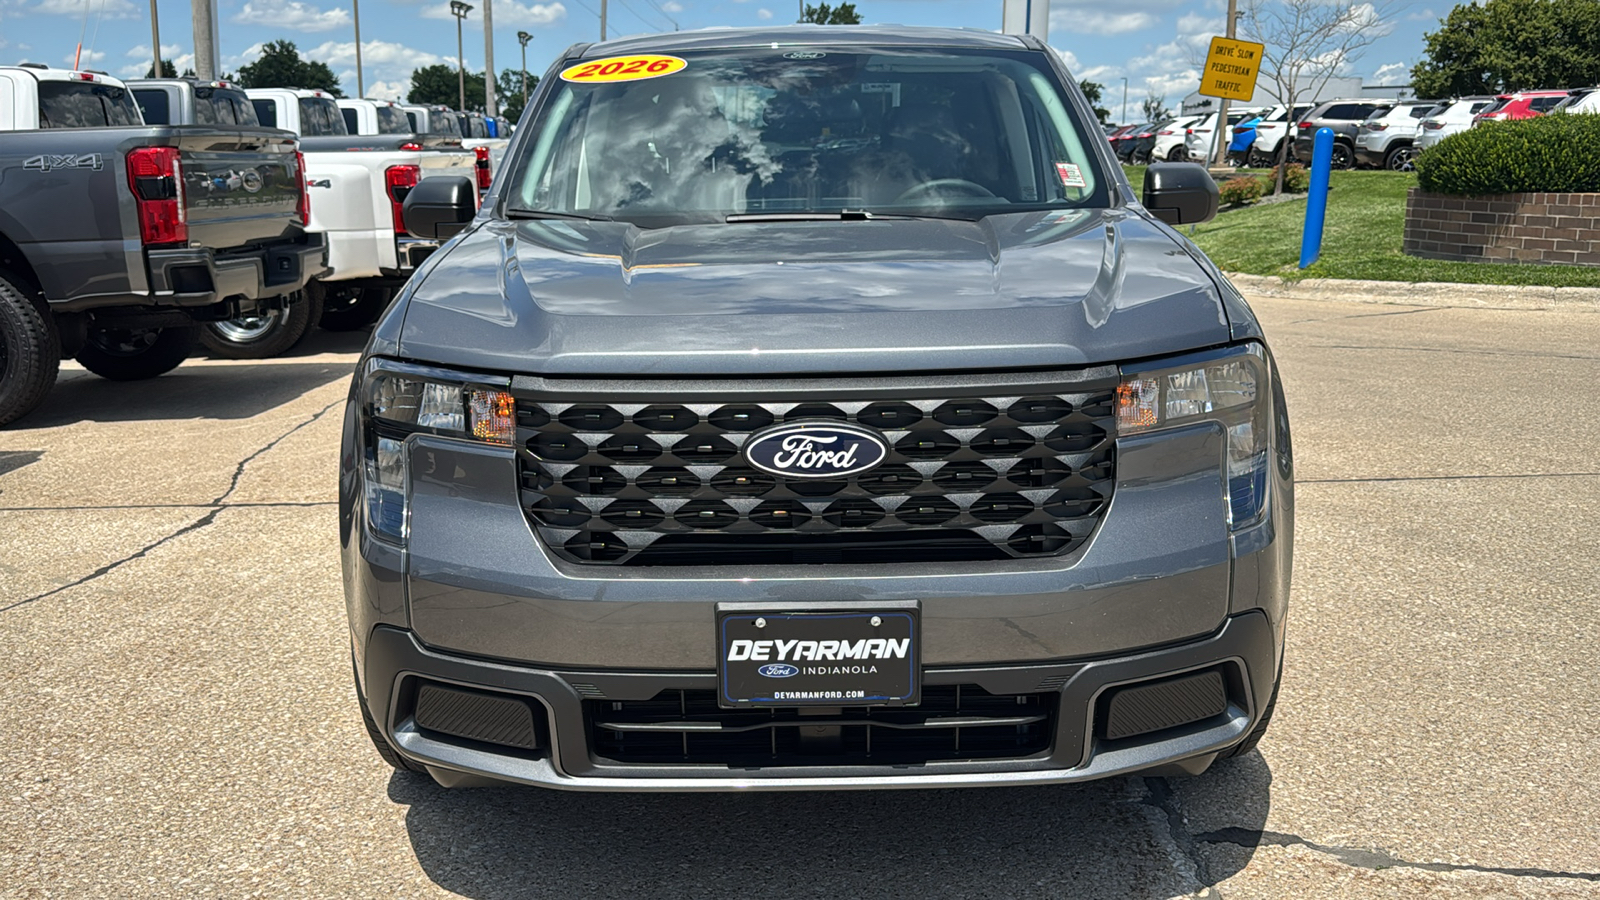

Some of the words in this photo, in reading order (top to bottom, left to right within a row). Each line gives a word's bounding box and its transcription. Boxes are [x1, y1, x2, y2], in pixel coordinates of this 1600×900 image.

[1215, 45, 1235, 57] DRIVE
[1237, 48, 1255, 60] SLOW
[572, 60, 674, 78] 2026
[1211, 62, 1251, 76] PEDESTRIAN
[1215, 80, 1241, 92] TRAFFIC
[773, 434, 859, 468] Ford
[727, 638, 910, 661] DEYARMAN
[766, 665, 790, 675] Ford
[802, 665, 878, 675] INDIANOLA
[774, 690, 865, 699] DEYARMANFORD.COM
